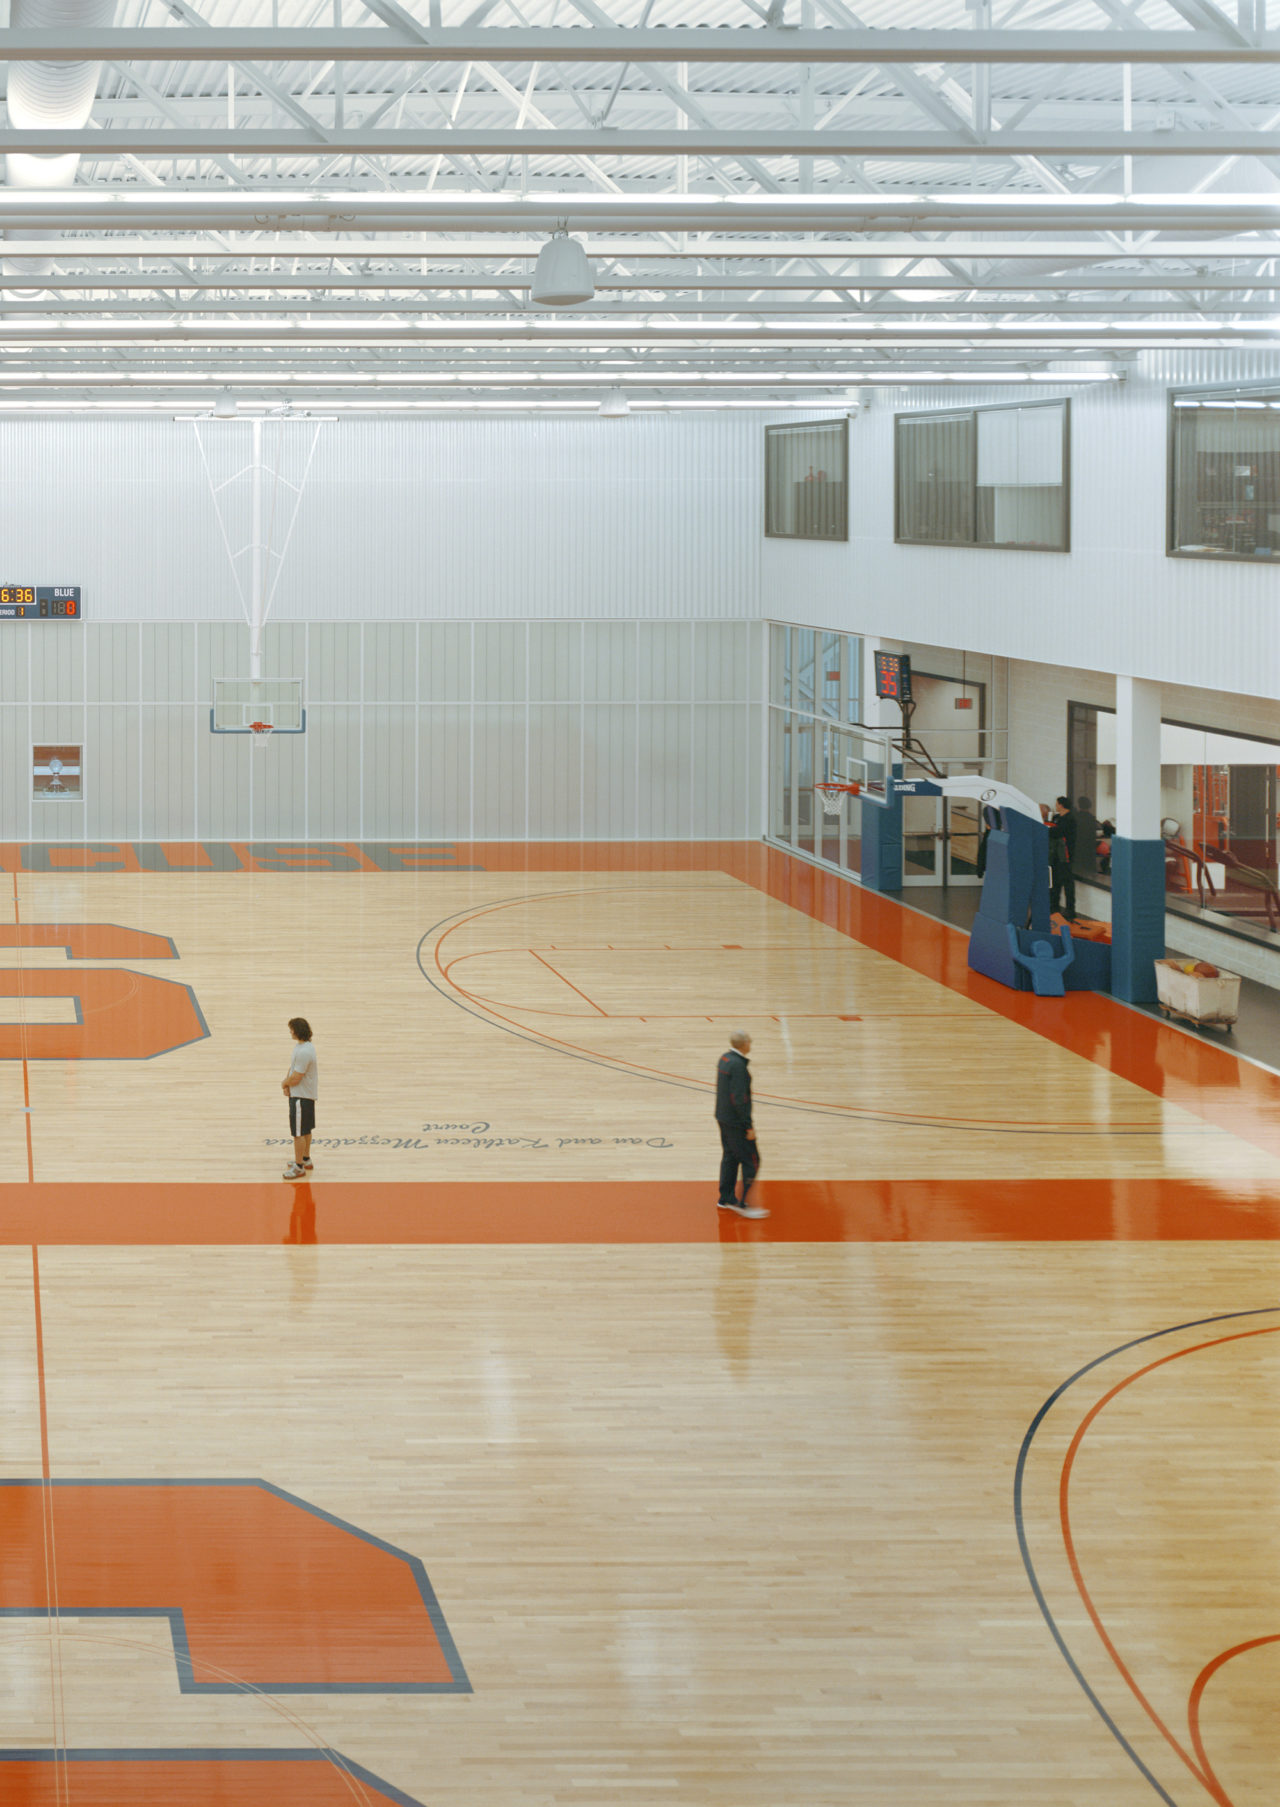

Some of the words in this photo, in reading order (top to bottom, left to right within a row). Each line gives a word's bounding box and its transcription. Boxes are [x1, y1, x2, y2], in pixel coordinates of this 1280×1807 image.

[0, 588, 33, 603] 6:36
[54, 588, 75, 597] BLUE
[880, 670, 897, 696] 35
[422, 1121, 490, 1134] Court
[265, 1135, 428, 1149] Mezzalinua
[436, 1137, 549, 1149] Kathleen
[557, 1137, 602, 1148] and
[613, 1137, 674, 1148] Dan
